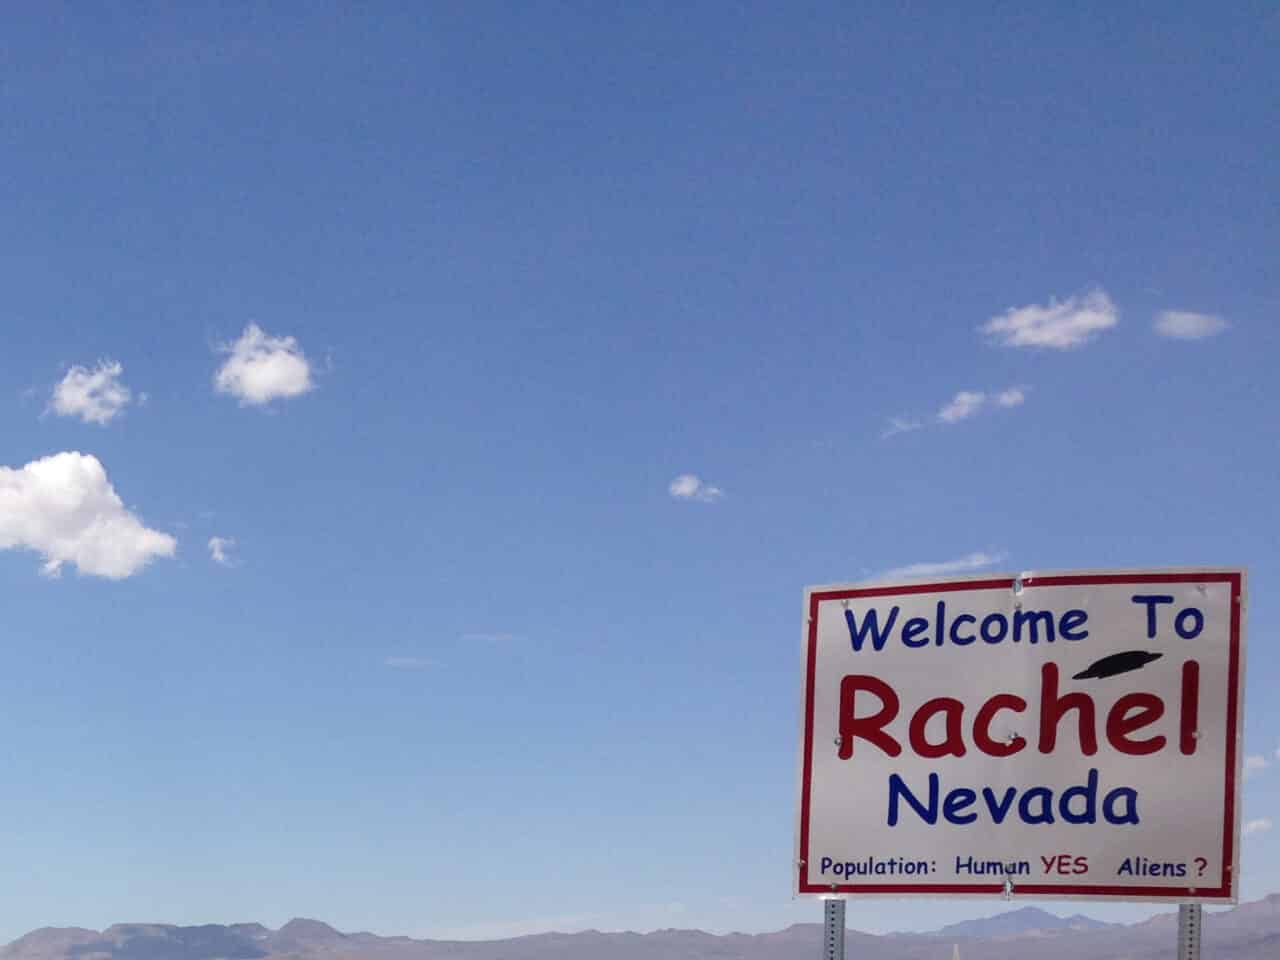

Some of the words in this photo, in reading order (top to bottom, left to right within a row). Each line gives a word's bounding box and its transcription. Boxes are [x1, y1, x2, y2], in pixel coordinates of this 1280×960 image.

[845, 601, 1089, 651] Welcome
[1131, 595, 1204, 639] To
[838, 661, 1199, 760] Rachel
[887, 768, 1139, 827] Nevada
[820, 857, 937, 880] Population:
[955, 856, 1030, 875] Human
[1041, 855, 1089, 874] YES
